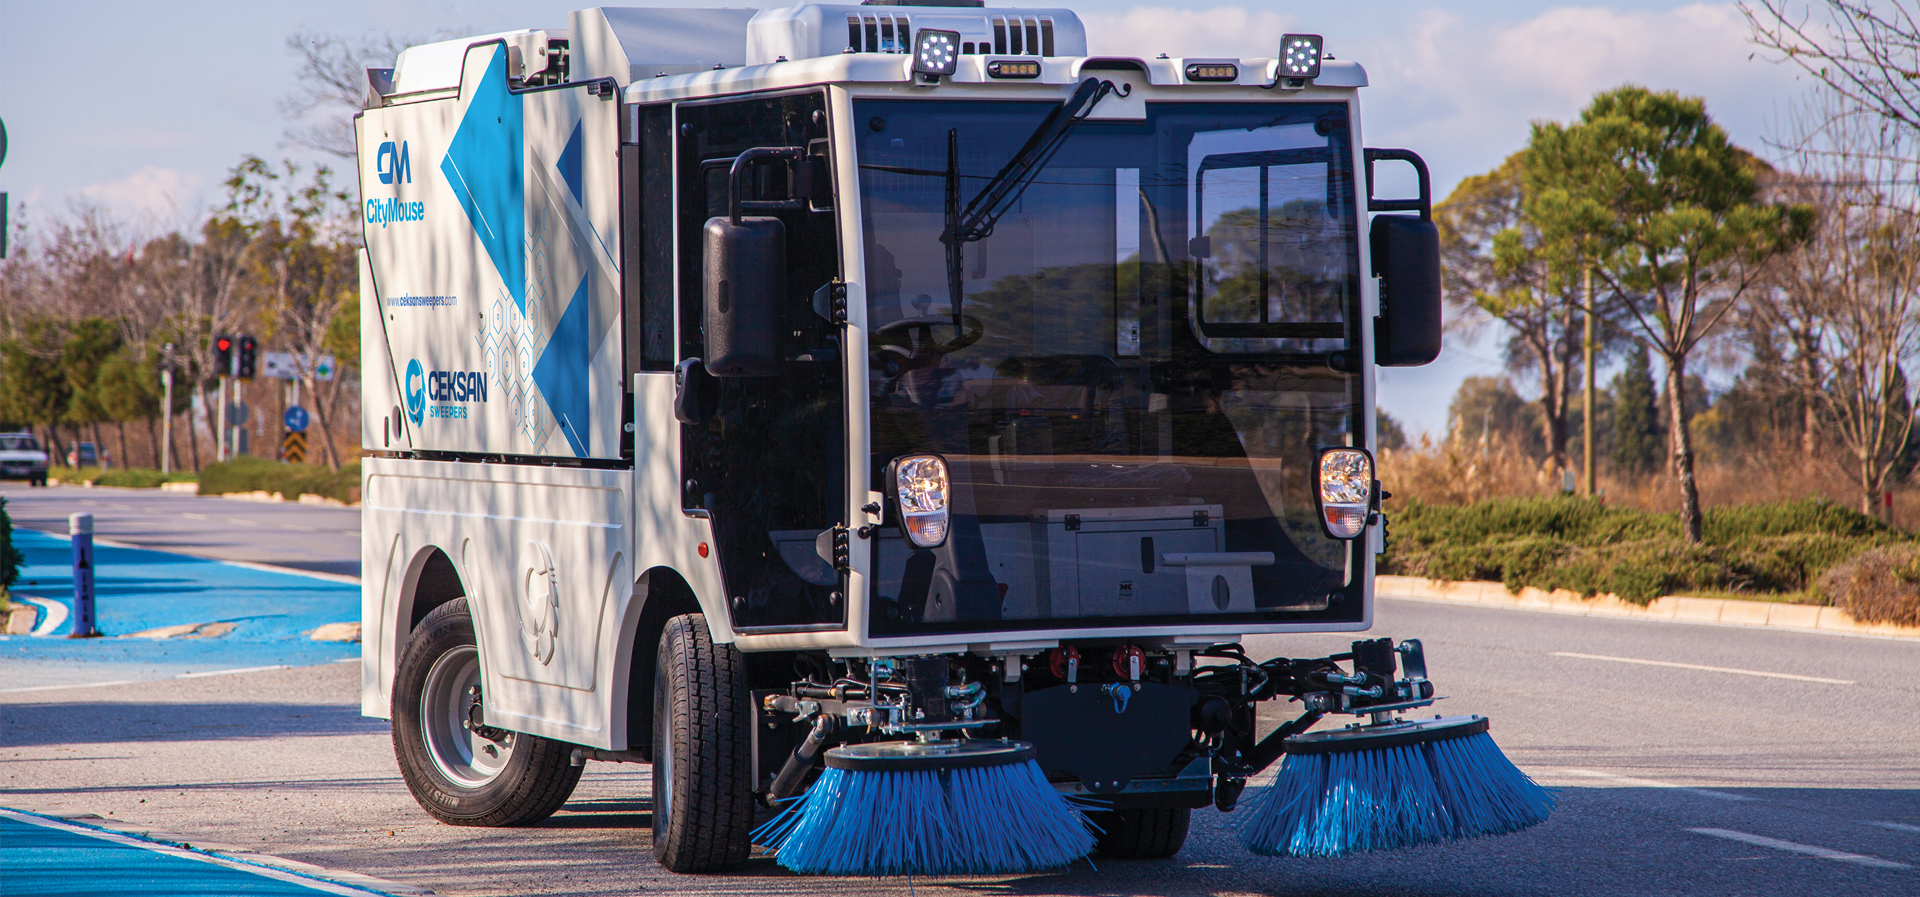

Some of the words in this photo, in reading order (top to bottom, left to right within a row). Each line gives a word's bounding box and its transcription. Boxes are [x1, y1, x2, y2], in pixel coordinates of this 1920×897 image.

[377, 140, 412, 184] CM
[366, 197, 424, 228] CityMouse
[386, 292, 457, 310] www.ceksansweepers.com
[428, 371, 487, 402] CEKSAN
[430, 405, 467, 419] SWEEPERS
[413, 769, 460, 808] MILESTON
